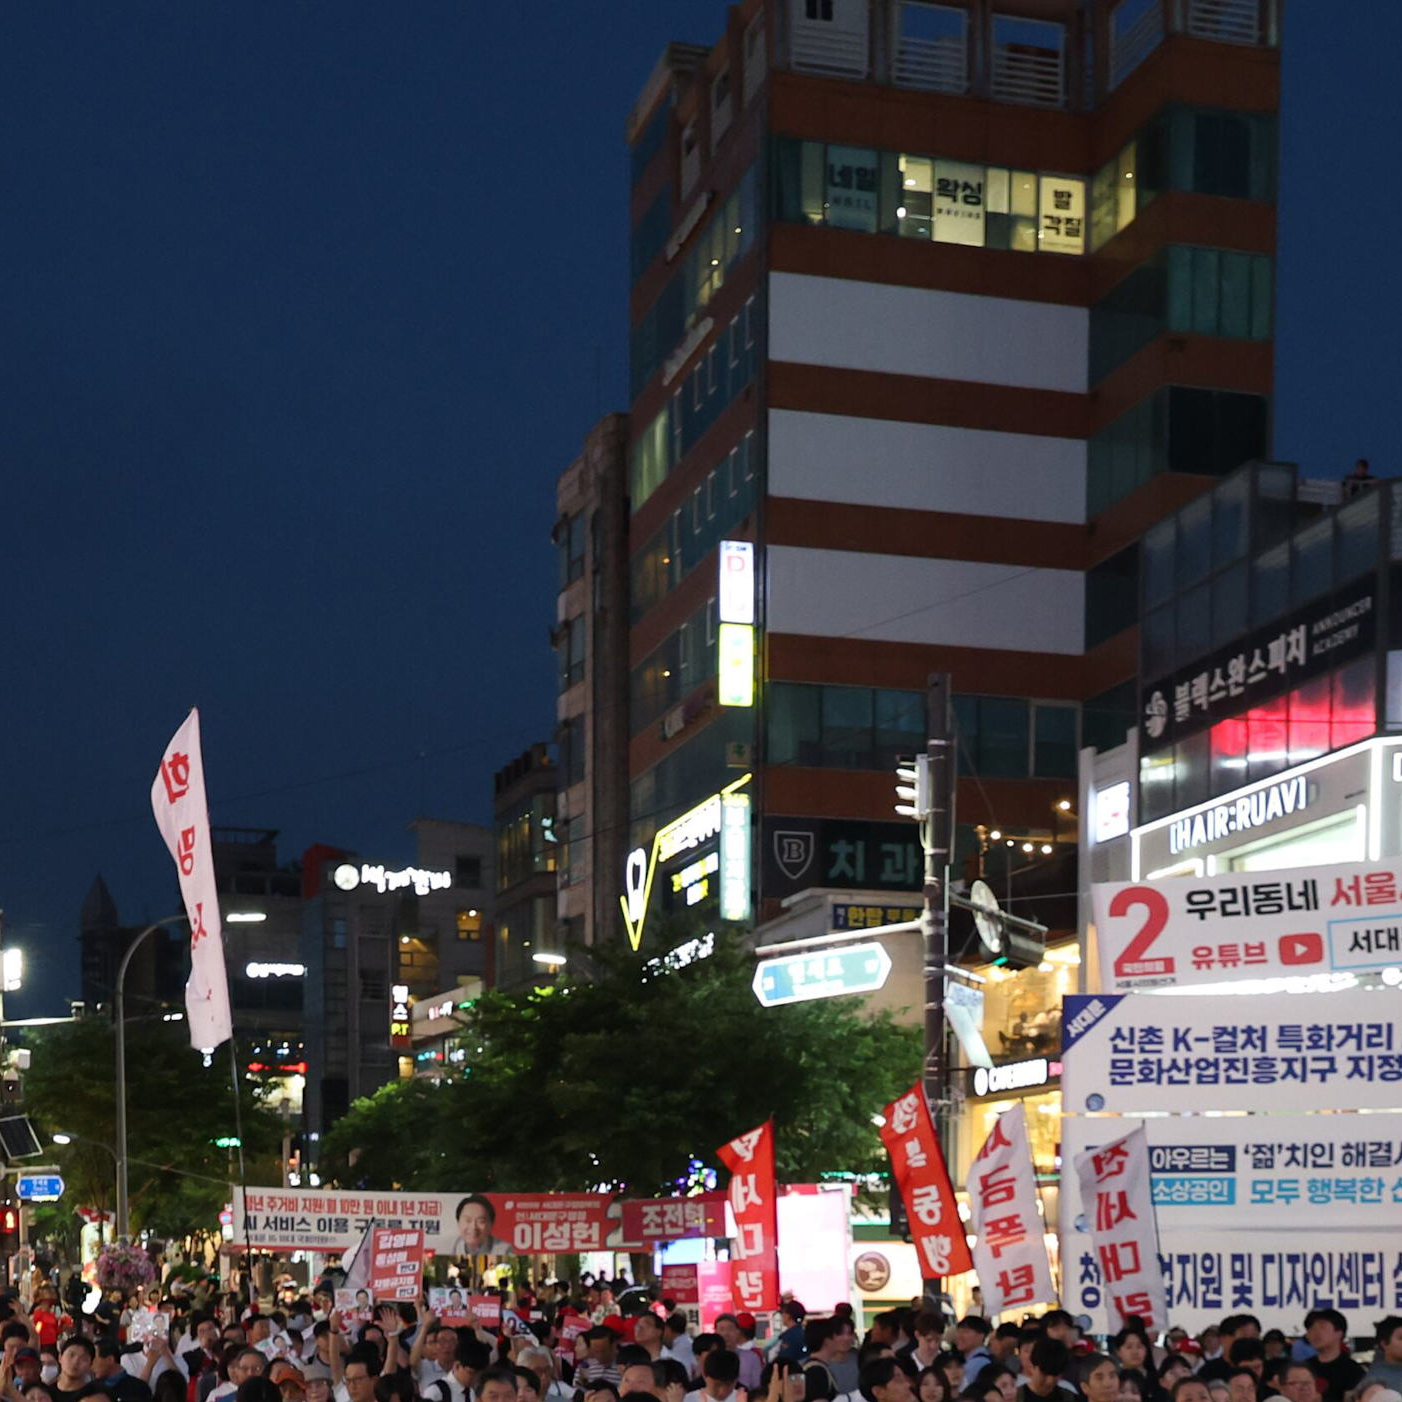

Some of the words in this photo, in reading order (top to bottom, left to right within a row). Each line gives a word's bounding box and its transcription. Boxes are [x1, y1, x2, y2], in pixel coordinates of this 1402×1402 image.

[829, 163, 878, 191] 네일
[936, 177, 982, 206] 왁싱
[1053, 190, 1074, 211] 발
[1042, 215, 1082, 238] 각질
[1174, 625, 1307, 722] 블랙스완스피치
[828, 840, 918, 884] 치과
[1186, 880, 1319, 920] 우리동네
[1109, 886, 1174, 977] 2
[1121, 960, 1165, 974] 국민의힘
[1191, 942, 1269, 971] 유튜브
[1065, 999, 1108, 1039] 서대문
[1109, 1026, 1164, 1055] 신촌
[1173, 1025, 1268, 1055] K-컬처
[1277, 1022, 1395, 1053] 특화거리
[1109, 1055, 1339, 1086] 문화산업진흥지구
[1152, 1147, 1230, 1170] 아우르는
[1153, 1178, 1229, 1202] 소상공인
[1250, 1180, 1300, 1203] 모두
[1307, 1177, 1385, 1203] 행복한
[263, 1216, 311, 1232] 서비스
[317, 1216, 348, 1233] 이용
[514, 1222, 599, 1250] 이성헌
[1232, 1252, 1254, 1307] 및
[1261, 1252, 1384, 1308] 디자인센터
